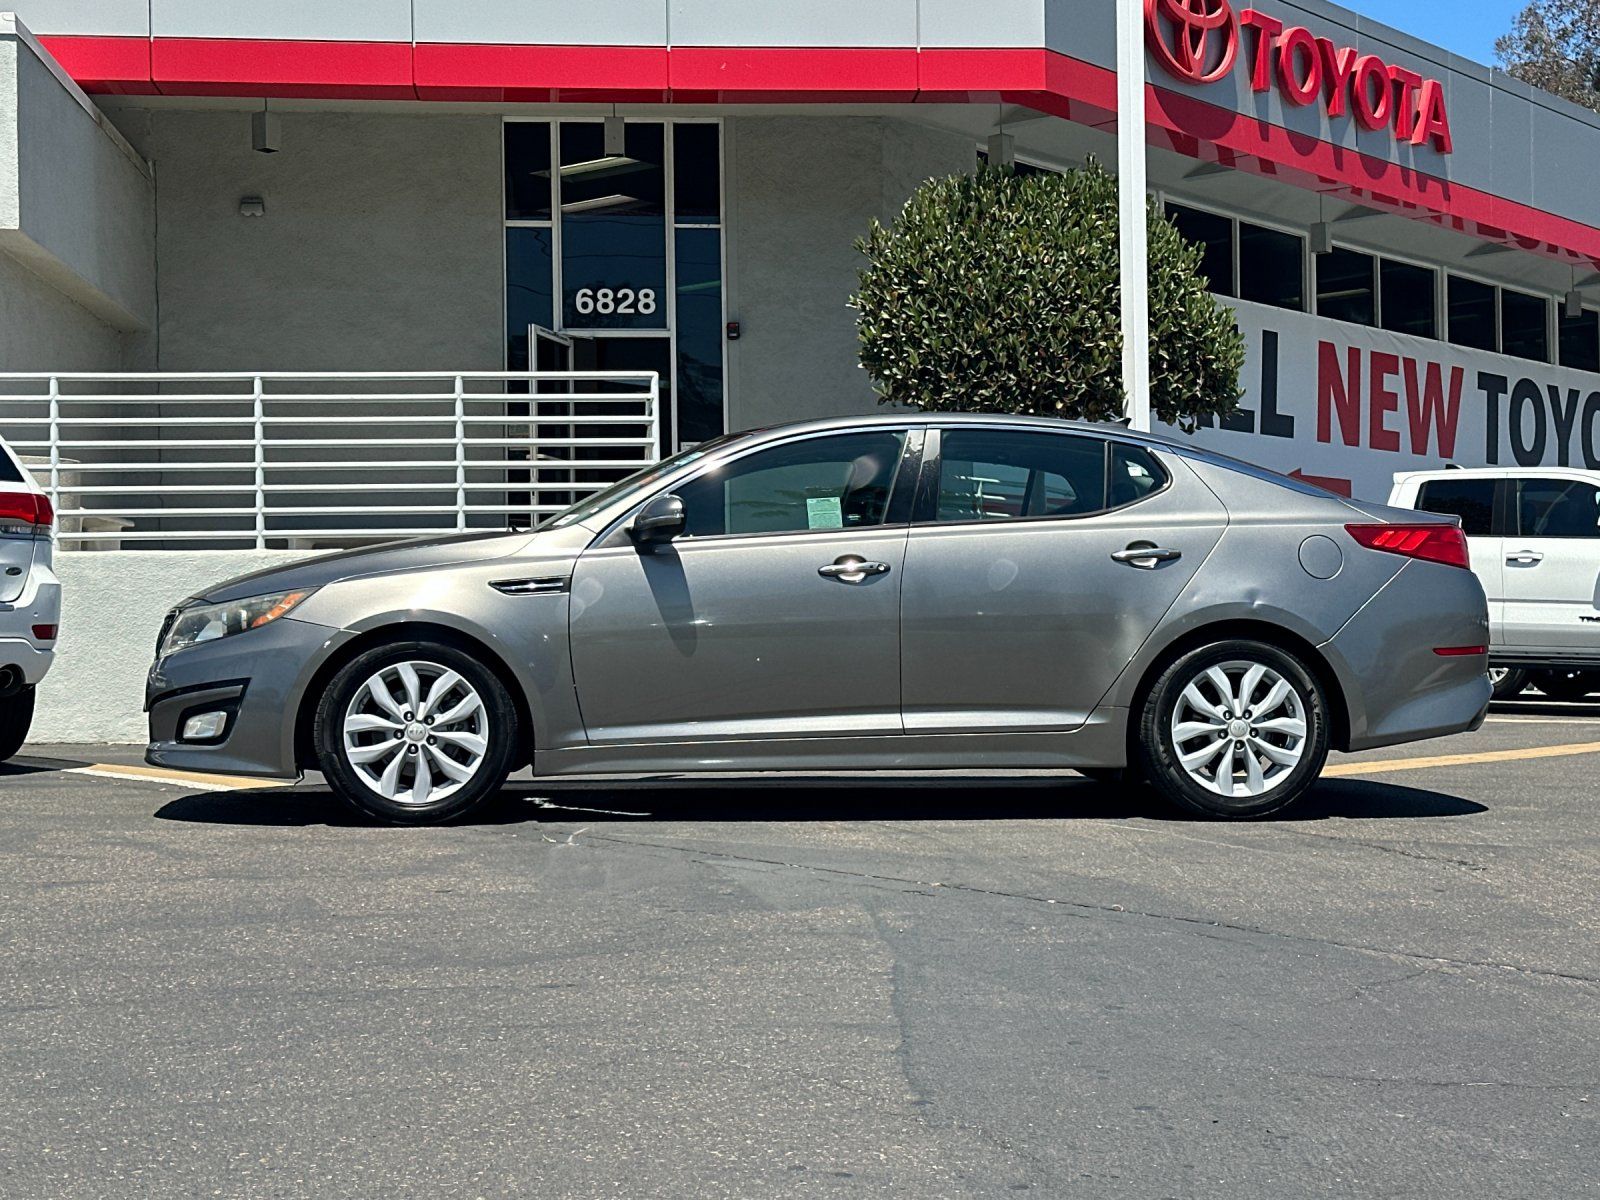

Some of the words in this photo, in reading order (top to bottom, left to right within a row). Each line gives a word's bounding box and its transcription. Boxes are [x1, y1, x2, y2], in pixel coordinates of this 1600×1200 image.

[1240, 8, 1453, 154] TOYOTA
[575, 288, 656, 314] 6828
[1316, 340, 1464, 459] NEW
